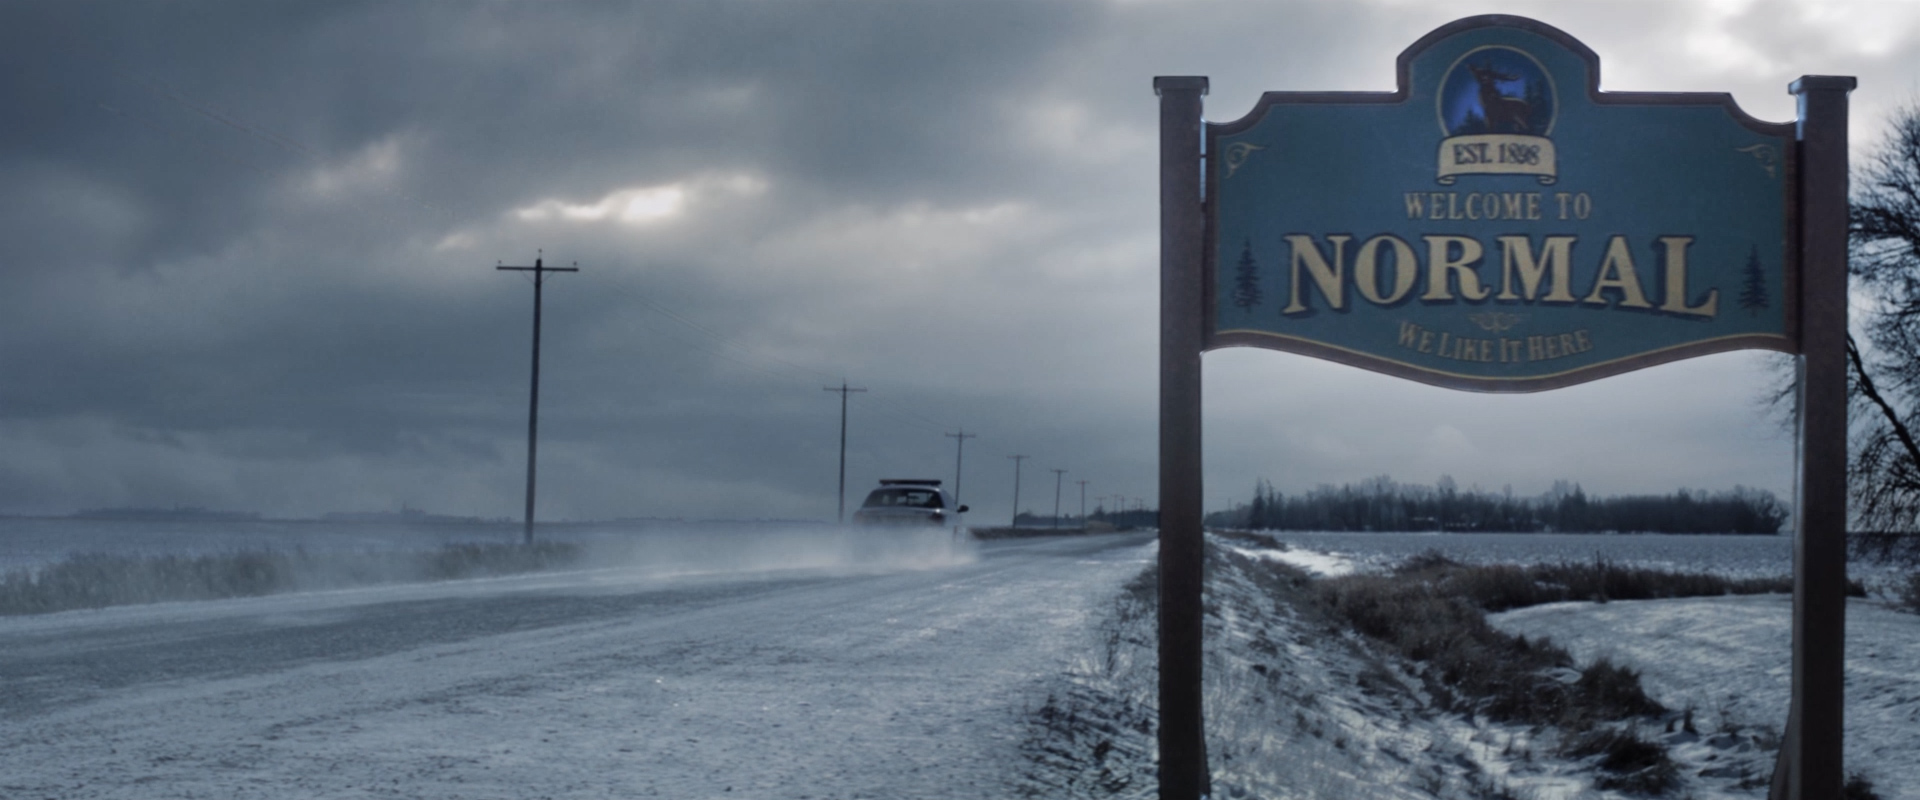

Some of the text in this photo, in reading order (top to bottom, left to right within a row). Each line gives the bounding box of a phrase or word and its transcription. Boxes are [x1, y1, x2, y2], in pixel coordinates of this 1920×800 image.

[1404, 192, 1592, 220] WELCOME TO
[1282, 234, 1719, 318] NORMAL
[1399, 320, 1593, 363] WE LIKE IT HERE
